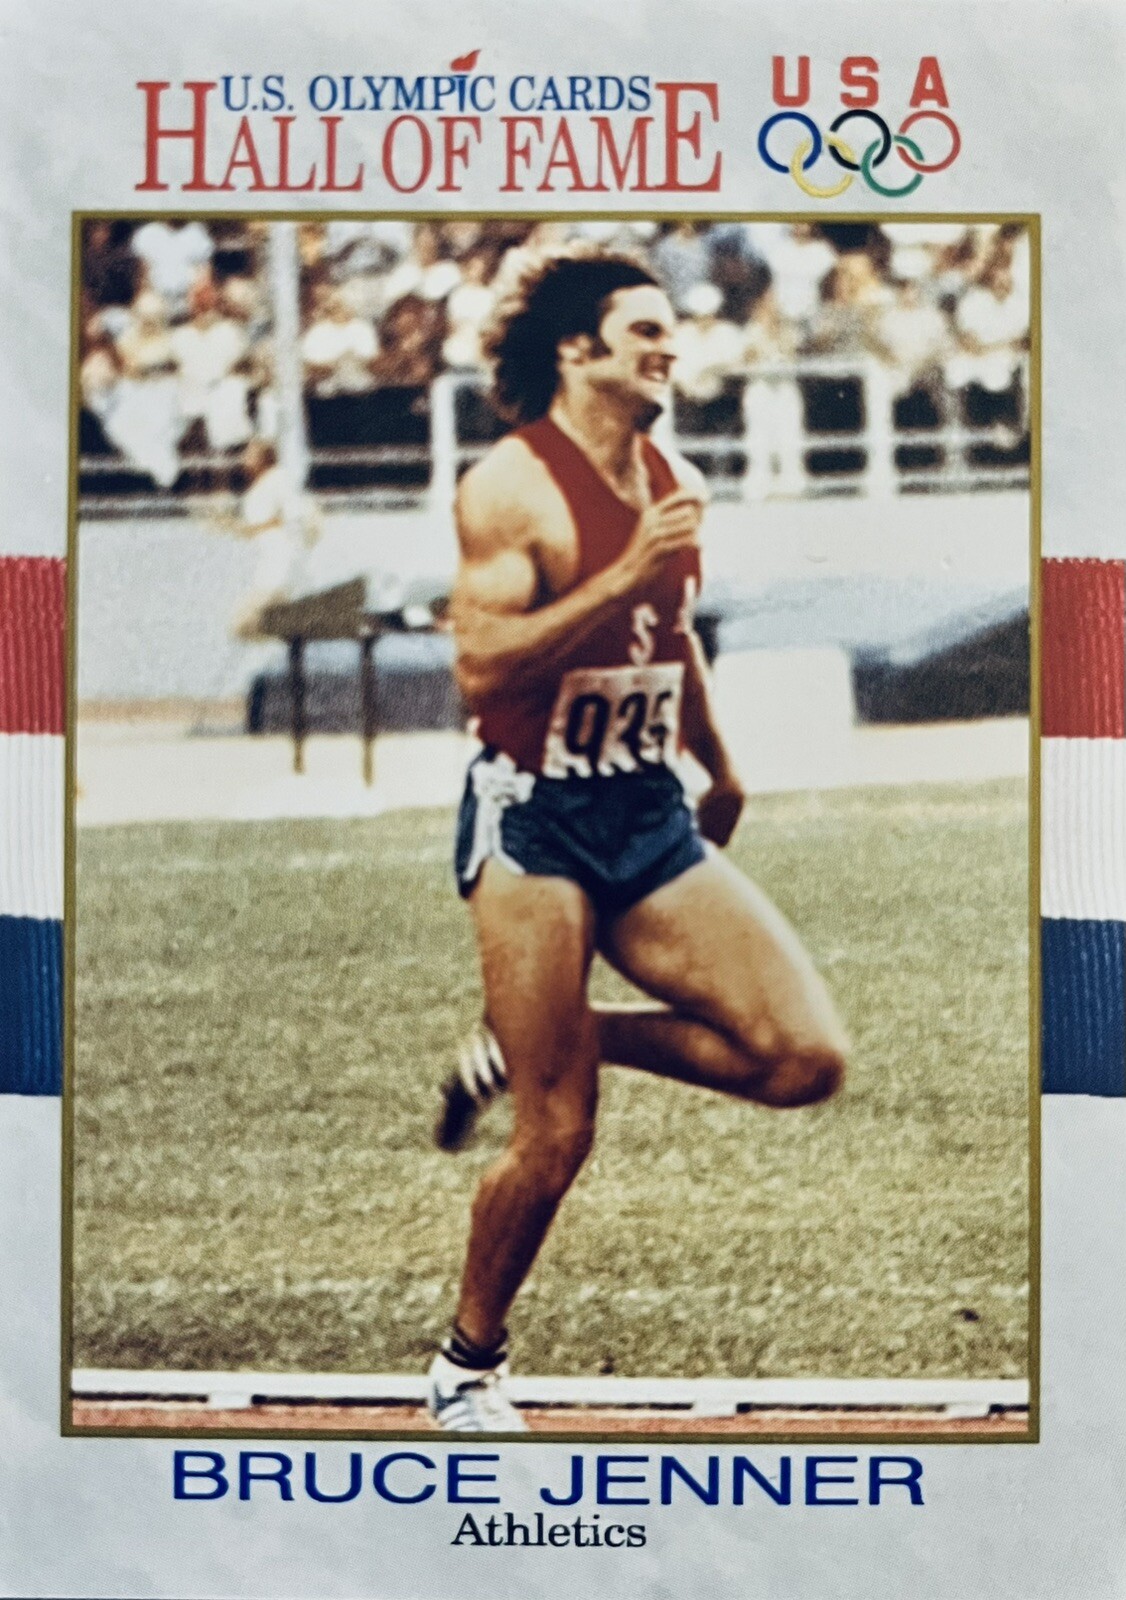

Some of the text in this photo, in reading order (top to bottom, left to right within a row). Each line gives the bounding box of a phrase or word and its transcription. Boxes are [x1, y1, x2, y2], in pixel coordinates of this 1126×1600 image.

[221, 74, 652, 113] U.S. OLYMPIC CARDS
[134, 80, 722, 193] HALL OF FAME
[172, 1449, 925, 1507] BRUCE JENNER
[450, 1512, 648, 1549] Athletics
